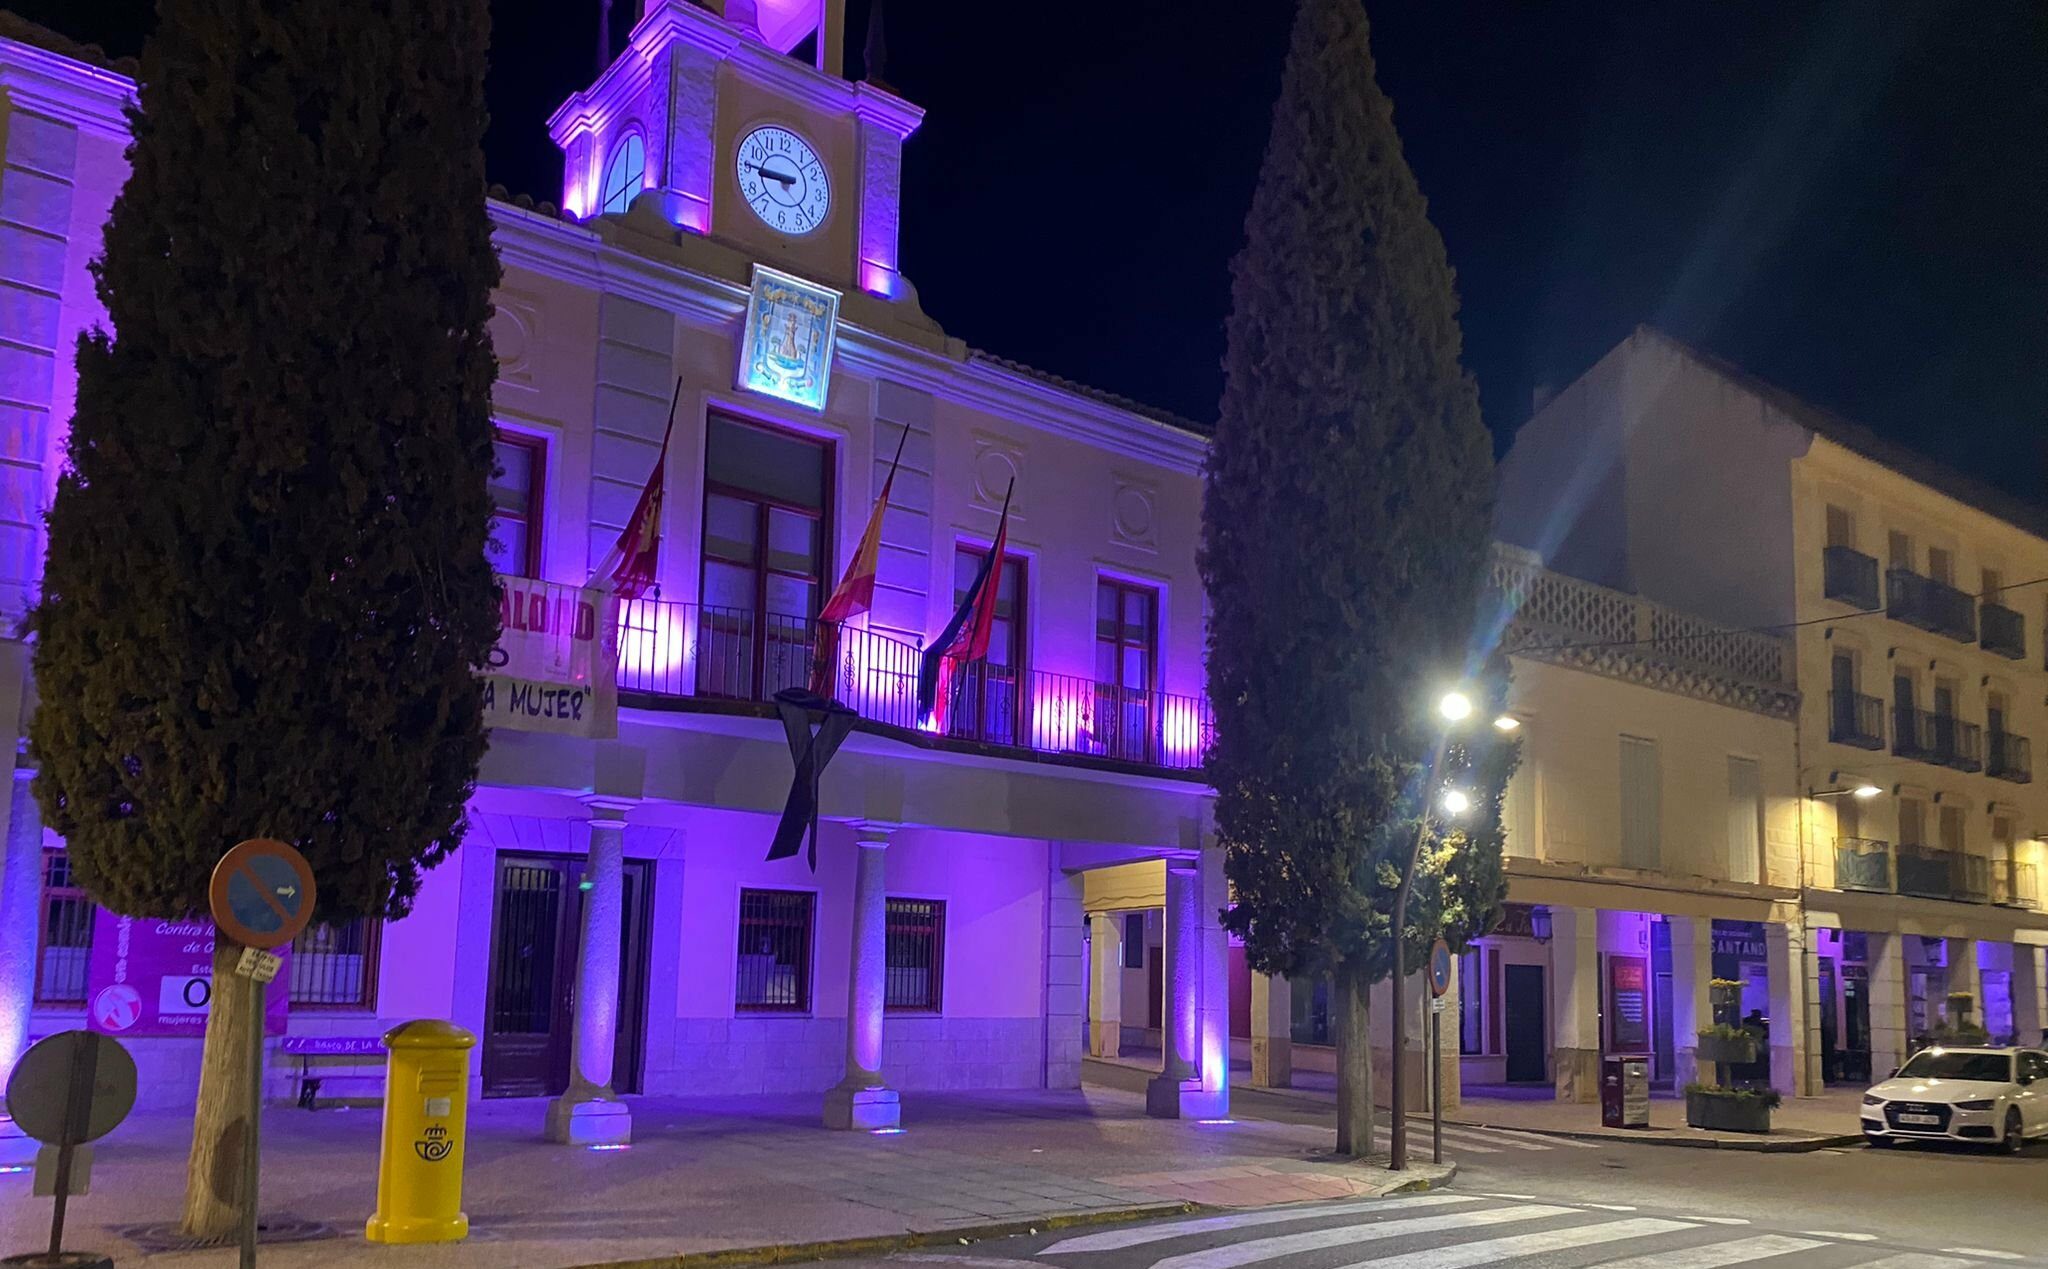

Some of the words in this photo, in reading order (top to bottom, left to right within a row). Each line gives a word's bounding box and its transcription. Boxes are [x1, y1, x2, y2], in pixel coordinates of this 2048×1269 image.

[765, 136, 774, 151] 11
[779, 137, 792, 154] 12
[751, 145, 764, 161] 10
[810, 167, 818, 181] 2
[748, 181, 757, 195] 8
[815, 188, 823, 202] 3
[761, 198, 770, 213] 7
[807, 204, 815, 218] 4
[777, 210, 786, 225] 6
[795, 213, 803, 226] 5
[155, 922, 201, 936] Contra
[183, 941, 201, 954] de
[158, 1015, 202, 1026] mujeres
